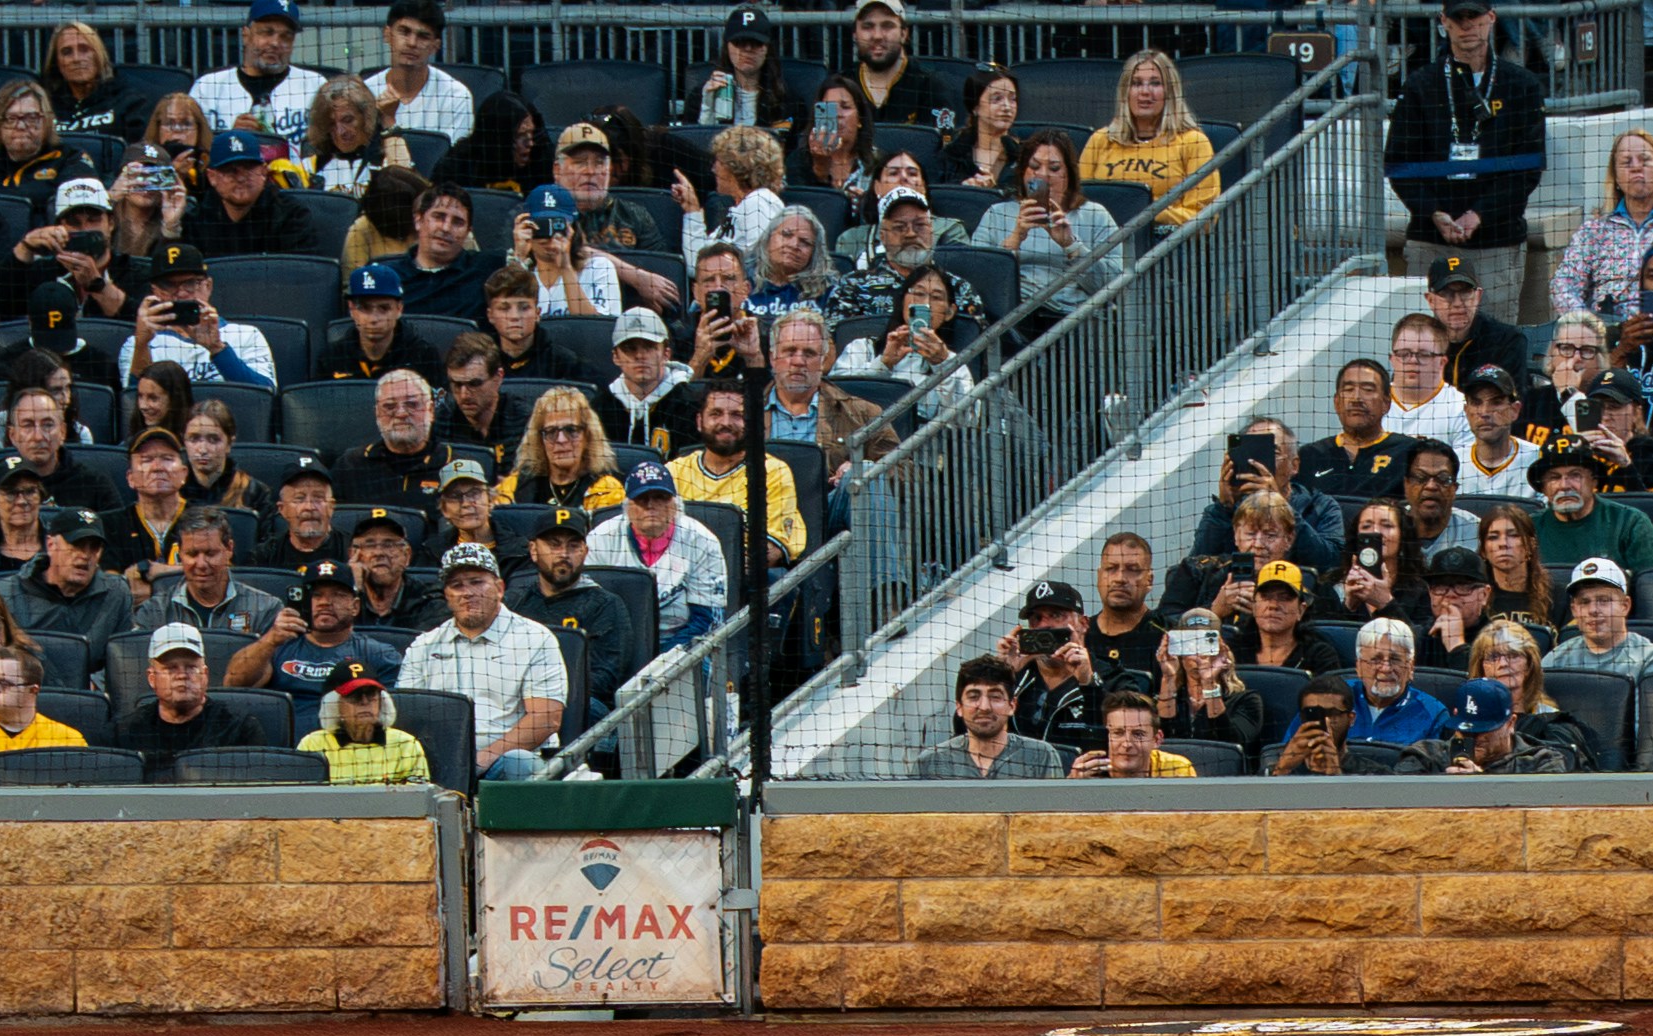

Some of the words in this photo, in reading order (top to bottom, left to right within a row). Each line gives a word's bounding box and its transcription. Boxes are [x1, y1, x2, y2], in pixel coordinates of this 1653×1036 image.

[743, 12, 754, 25] P
[1289, 43, 1314, 62] 19
[1492, 100, 1502, 115] P
[581, 126, 592, 138] P
[1105, 157, 1169, 180] YINZ
[542, 191, 555, 207] LA
[167, 247, 180, 264] P
[1447, 258, 1460, 271] P
[362, 271, 376, 288] LA
[48, 310, 62, 328] P
[1555, 438, 1569, 454] P
[5, 457, 21, 469] P
[299, 457, 312, 467] P
[1371, 455, 1391, 474] P
[371, 509, 387, 518] P
[556, 509, 570, 524] P
[1274, 563, 1287, 575] P
[348, 664, 364, 677] P
[1465, 695, 1477, 715] LA
[583, 852, 619, 863] RE/MAX
[509, 905, 696, 941] RE/MAX
[534, 946, 675, 989] Select
[574, 981, 660, 992] REALTY
